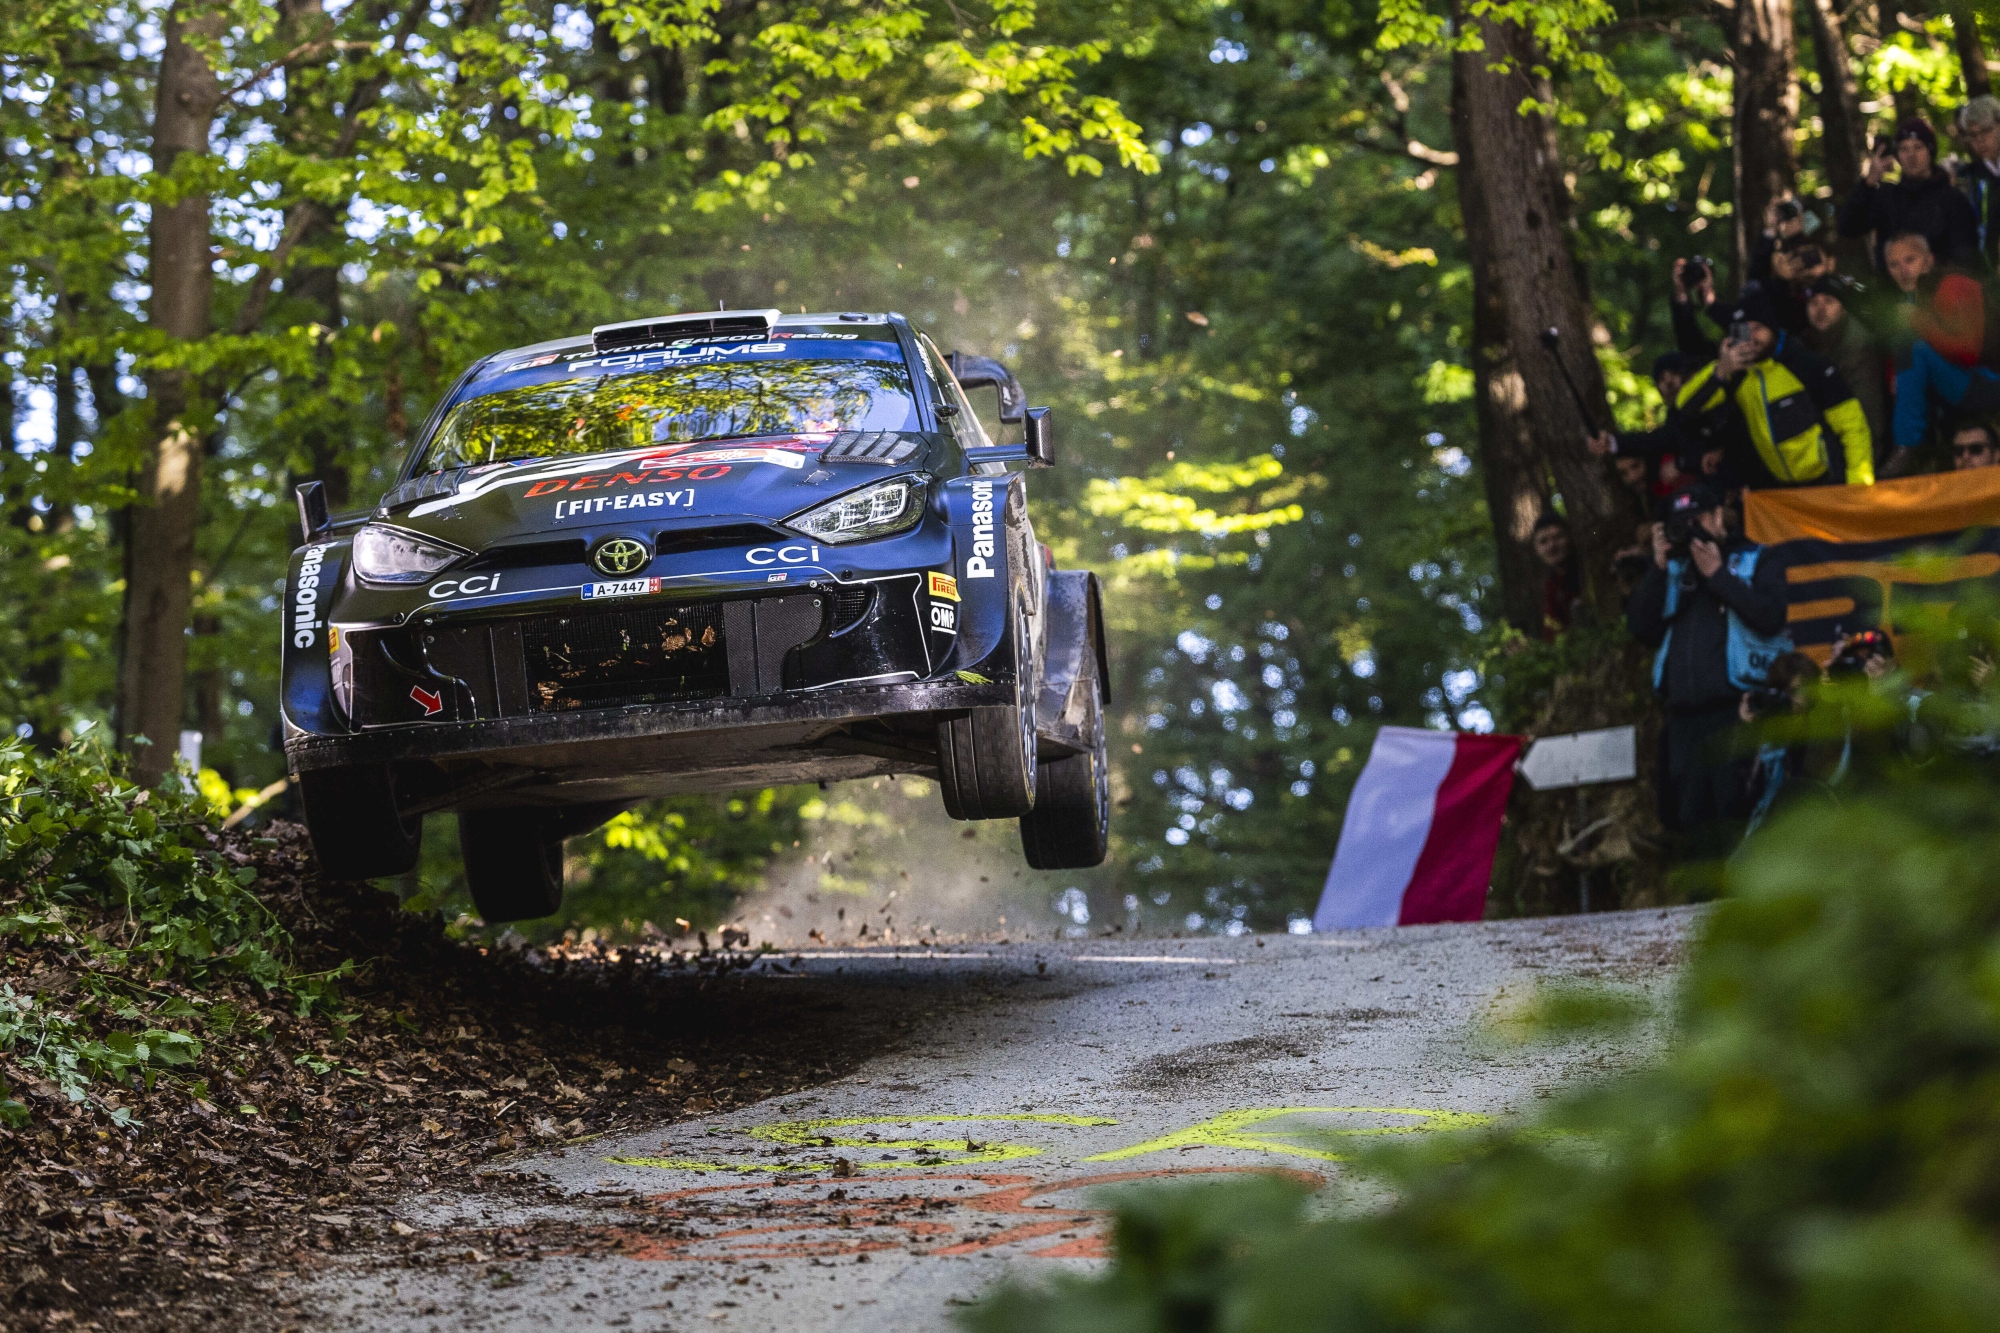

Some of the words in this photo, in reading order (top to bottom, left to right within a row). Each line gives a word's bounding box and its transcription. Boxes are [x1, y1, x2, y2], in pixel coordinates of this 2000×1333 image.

[563, 341, 664, 361] TOYOTA
[671, 333, 766, 347] GAZOO
[771, 332, 859, 341] Racing
[567, 342, 787, 372] FORUM8
[623, 354, 727, 370] フォーラムエイト
[523, 465, 732, 498] DENSO
[596, 581, 645, 596] A-7447
[931, 606, 955, 629] OMP
